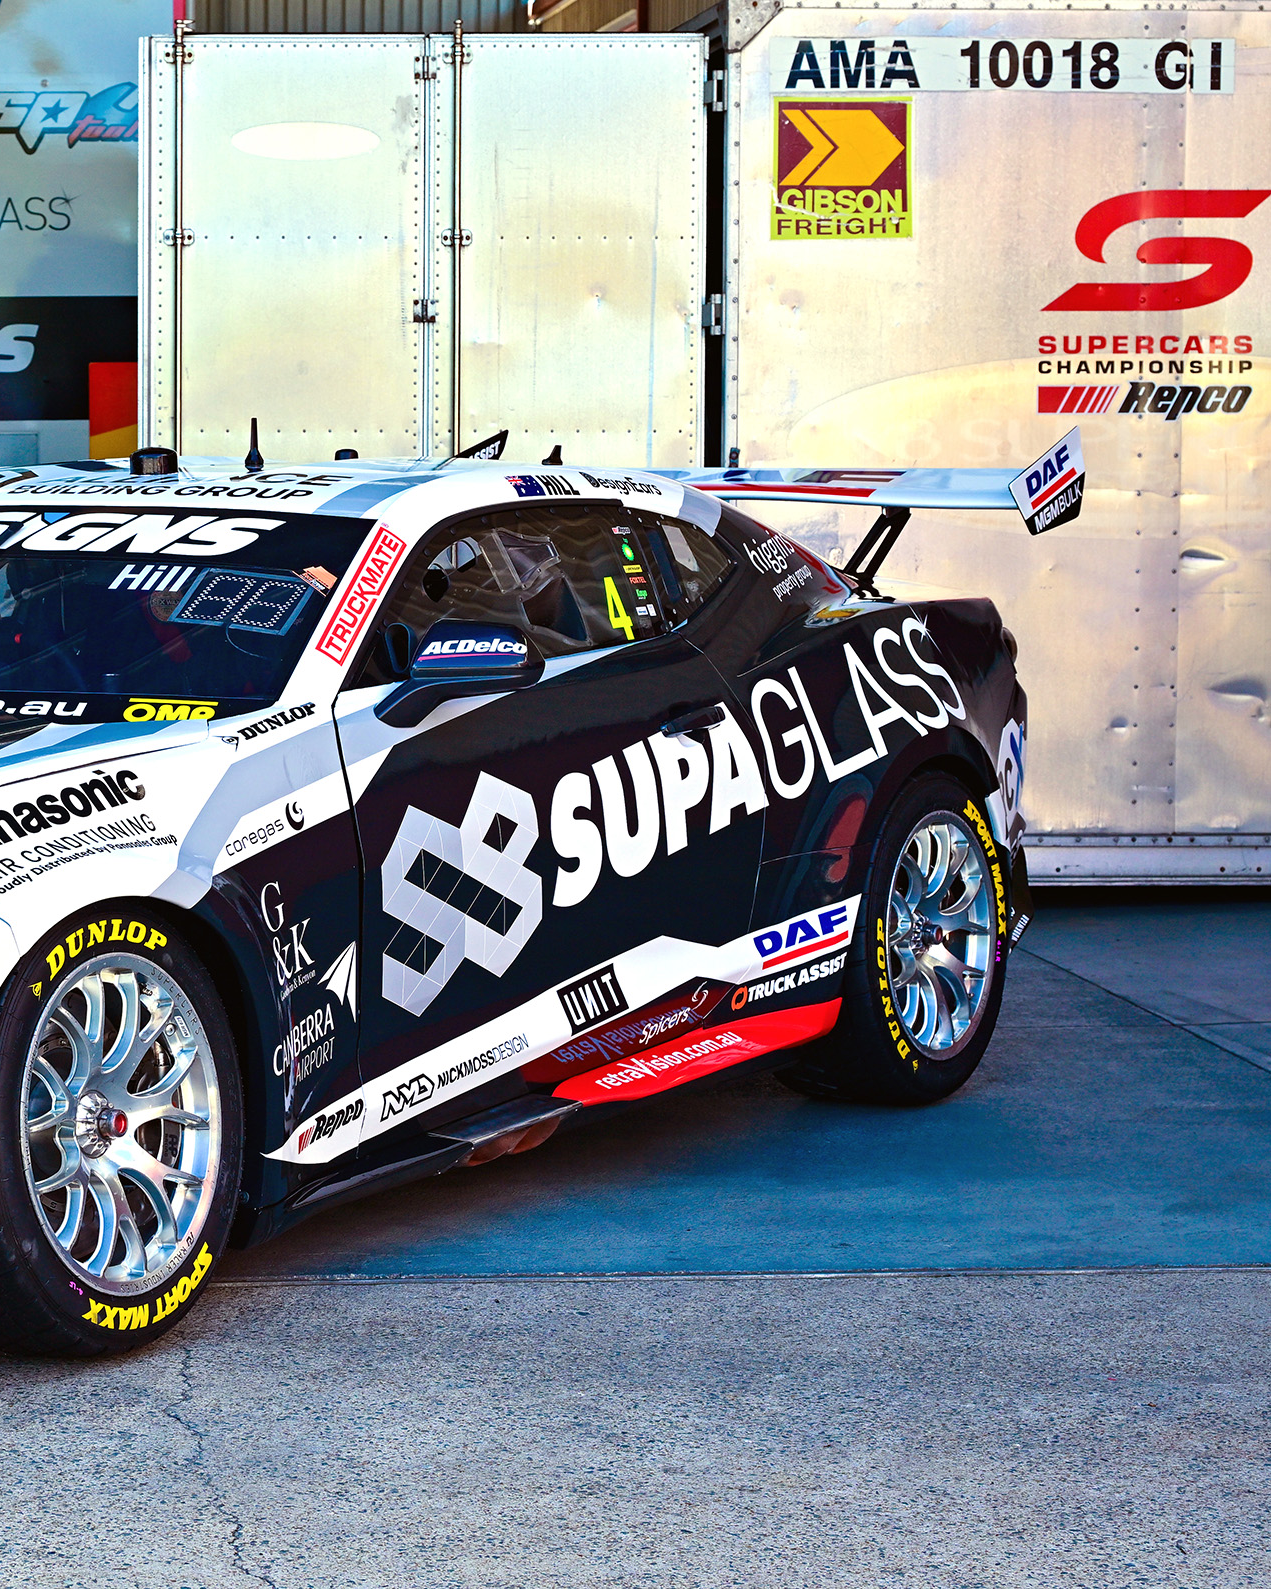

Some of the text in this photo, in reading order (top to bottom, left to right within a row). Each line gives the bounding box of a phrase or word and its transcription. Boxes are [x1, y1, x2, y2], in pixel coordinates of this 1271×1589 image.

[784, 40, 921, 89] AMA
[960, 40, 1120, 90] 10018
[67, 115, 138, 148] tool
[776, 216, 906, 236] FREIGHT
[781, 189, 903, 214] GIBSON
[1038, 335, 1253, 354] SUPERCARS
[1038, 360, 1253, 374] CHAMPIONSHIP
[1117, 382, 1253, 421] Repco
[8, 485, 314, 500] BUILDING GROUP
[535, 475, 580, 495] HILL
[1026, 444, 1069, 498] DAF
[1034, 481, 1083, 532] MGMBULK
[743, 530, 795, 574] higgins
[108, 564, 196, 592] Hill
[325, 534, 400, 653] TRUCKMATE
[772, 574, 801, 602] property
[603, 577, 635, 640] 4
[426, 638, 528, 656] ACDelco
[237, 702, 317, 741] DUNLOP
[550, 617, 967, 908] SUPAGLASS
[20, 812, 157, 863] CONDITIONING
[225, 819, 286, 857] coregas
[963, 799, 997, 858] SPORT
[30, 848, 96, 876] Distributed
[96, 845, 112, 854] by
[150, 834, 179, 847] Group
[260, 881, 285, 933] G
[991, 862, 1008, 938] MAXX
[46, 919, 168, 981] DUNLOP
[753, 905, 848, 958] DAF
[563, 975, 620, 1025] UNIT
[748, 951, 848, 1003] TRUCK ASSIST
[877, 918, 911, 1061] DUNLOP
[272, 1003, 335, 1077] CANBERRA
[640, 1006, 691, 1045] Spicers
[295, 1036, 336, 1087] AIRPORT
[595, 1030, 744, 1091] retraVision.com.au
[310, 1098, 365, 1143] Repco
[152, 1241, 213, 1324] SPORT
[81, 1298, 150, 1331] MAXX
